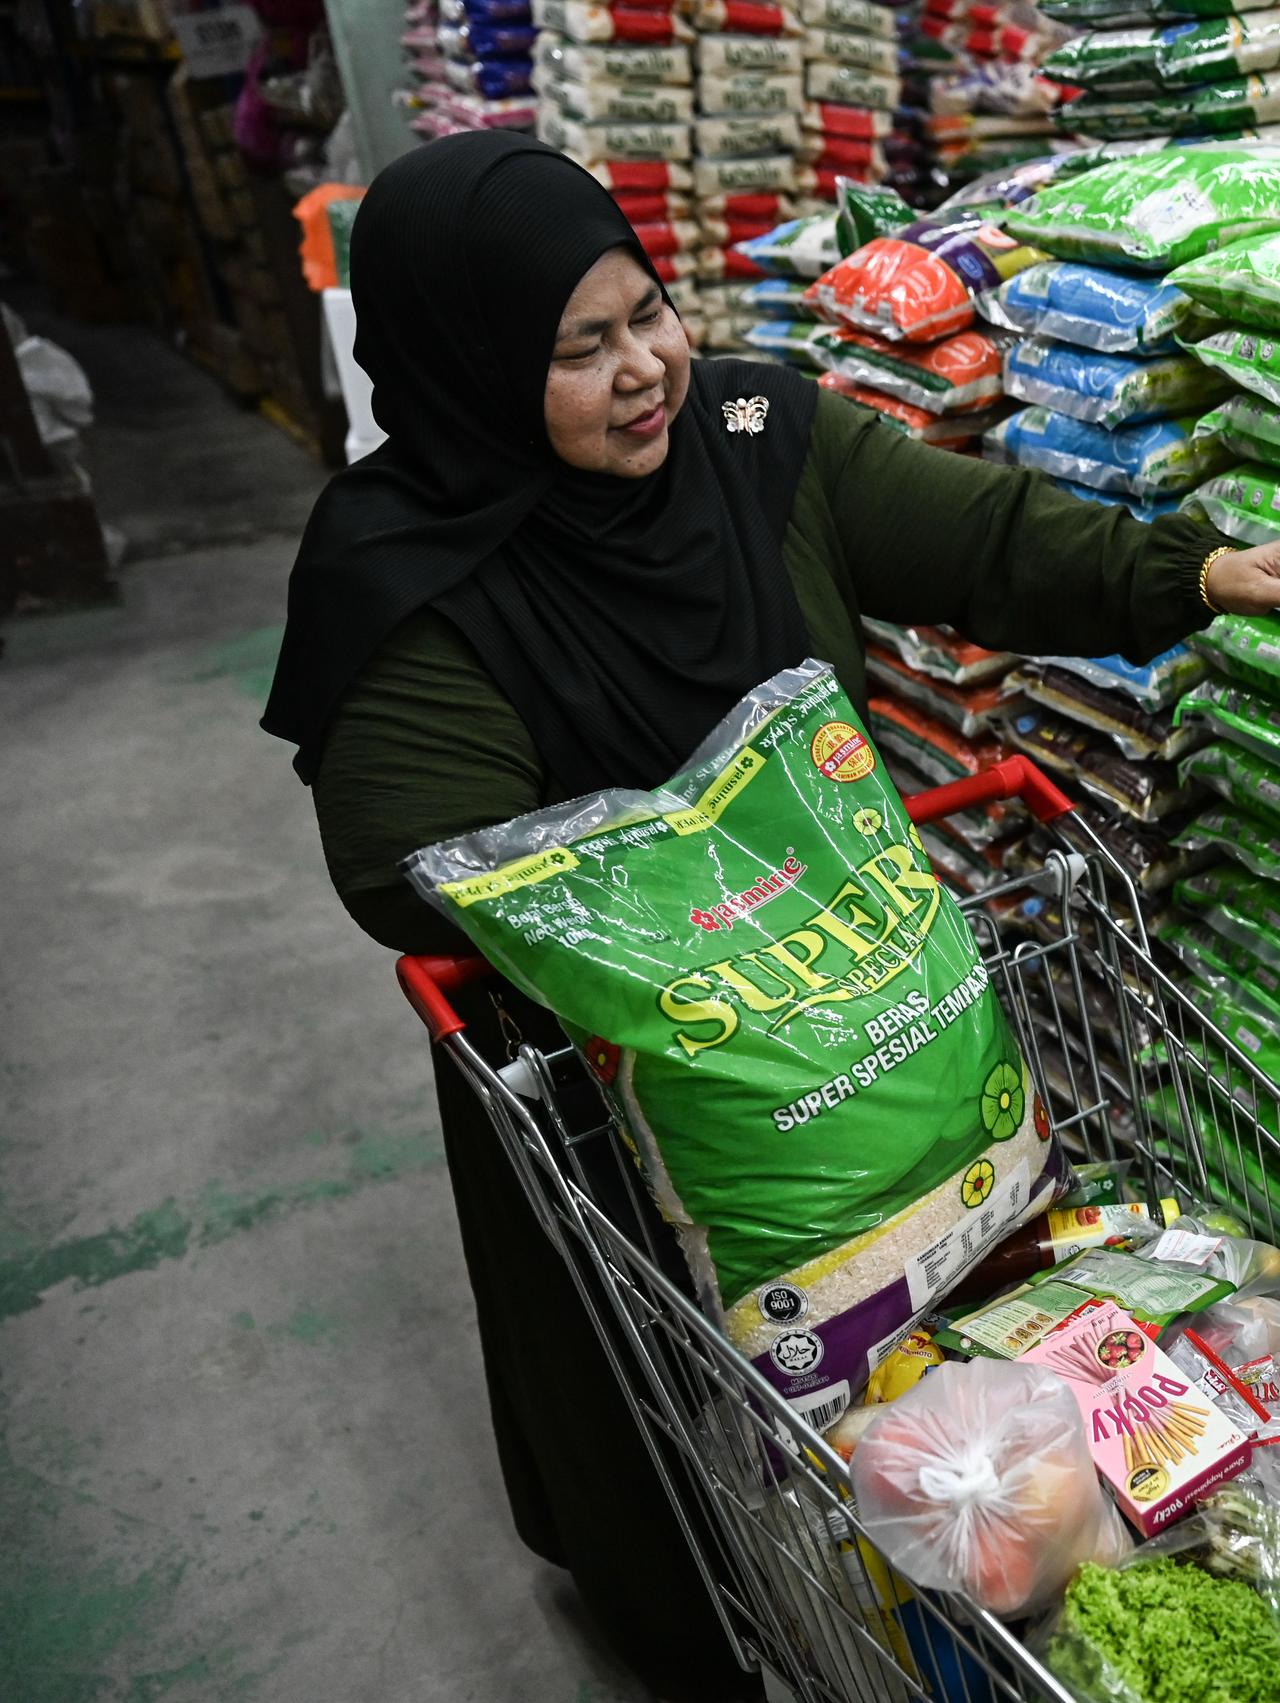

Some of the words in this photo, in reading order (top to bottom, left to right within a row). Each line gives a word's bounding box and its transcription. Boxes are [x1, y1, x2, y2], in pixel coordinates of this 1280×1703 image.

[656, 841, 941, 1061] SUPER
[863, 989, 930, 1047] BERAS
[772, 1074, 856, 1134] SUPER
[851, 1021, 938, 1089] SPESIAL
[770, 1298, 796, 1312] 9001
[771, 1291, 789, 1300] ISO
[1223, 1455, 1246, 1473] Share
[1183, 1468, 1224, 1504] happiness!
